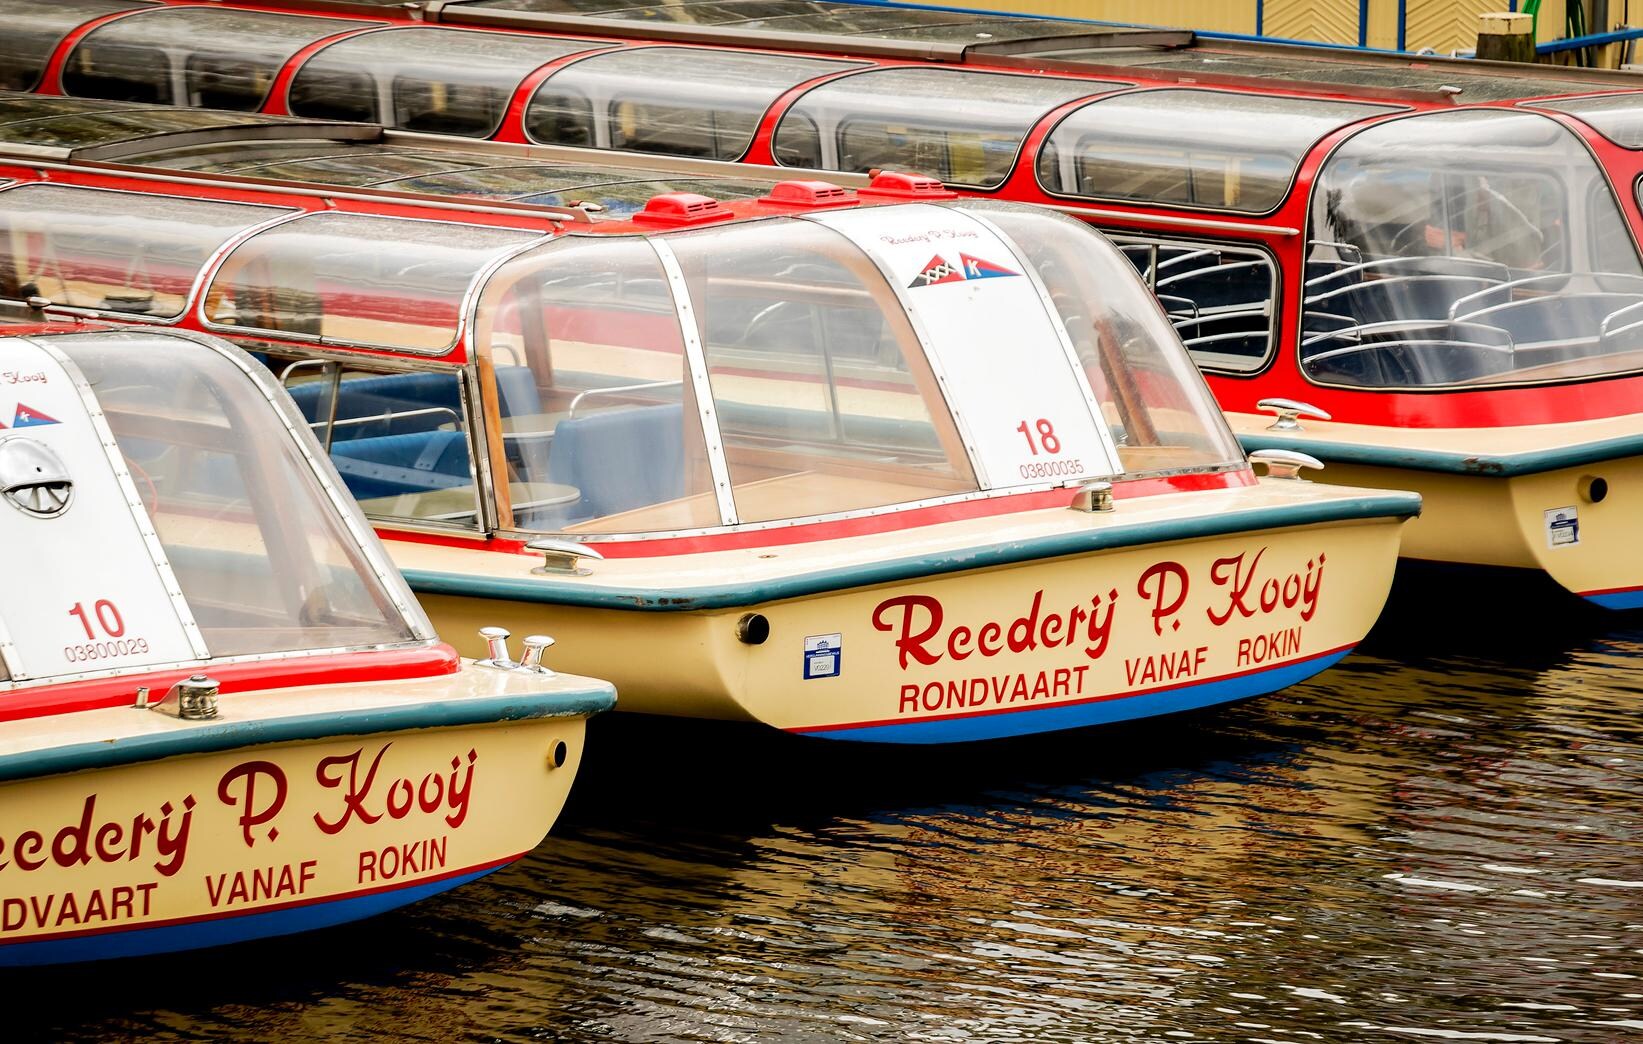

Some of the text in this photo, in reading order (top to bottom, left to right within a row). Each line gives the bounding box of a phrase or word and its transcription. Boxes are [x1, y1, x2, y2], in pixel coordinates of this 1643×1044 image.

[966, 259, 982, 276] K
[1016, 418, 1061, 455] 18
[1019, 459, 1084, 479] 03800035
[69, 599, 125, 640] 10
[871, 545, 1327, 671] Reederij P. Kooij
[64, 638, 149, 662] 03800029
[898, 626, 1302, 713] RONDVAART VANAF ROKIN
[217, 760, 289, 848] P.
[313, 741, 478, 835] Kooij
[2, 835, 447, 932] DVAART VANAF ROKIN
